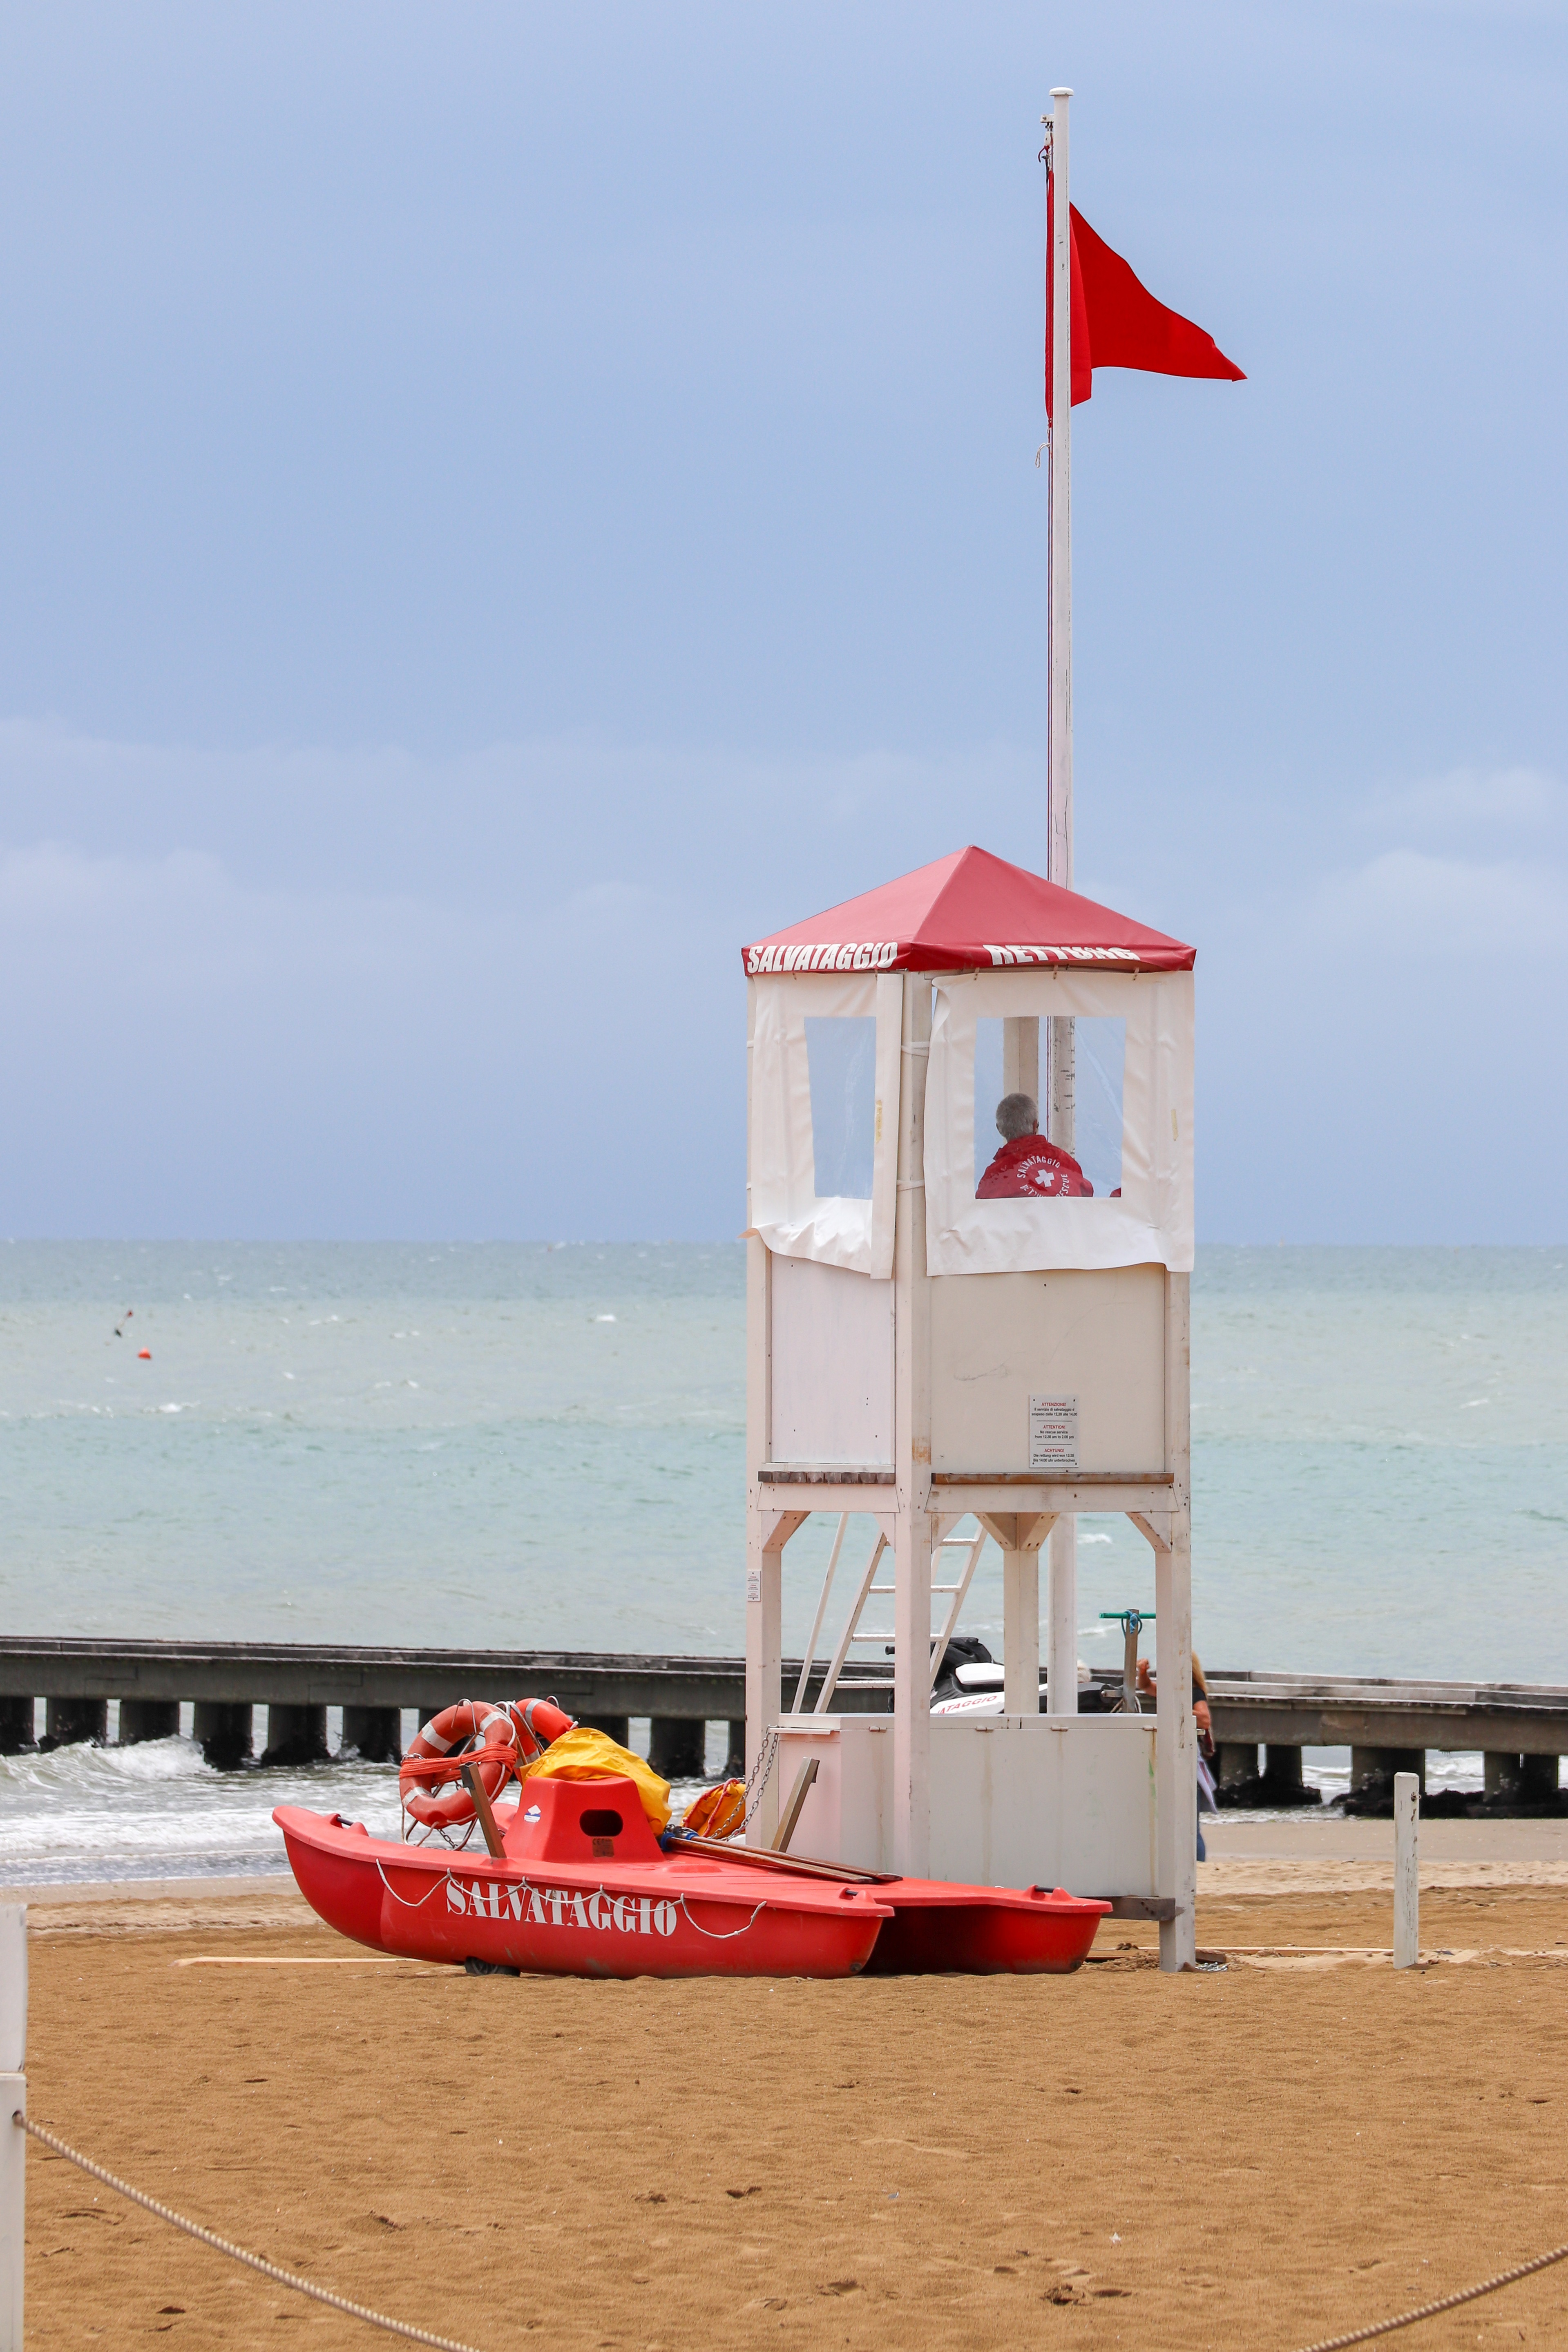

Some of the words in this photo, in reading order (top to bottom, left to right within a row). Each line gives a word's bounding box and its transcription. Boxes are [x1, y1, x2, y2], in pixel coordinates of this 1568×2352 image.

[747, 942, 898, 974] SALVATAGGIO
[982, 944, 1141, 965] RETTUNG
[1016, 1155, 1061, 1179] SALVATAGGIO
[446, 1878, 677, 1937] SALVATAGGIO
